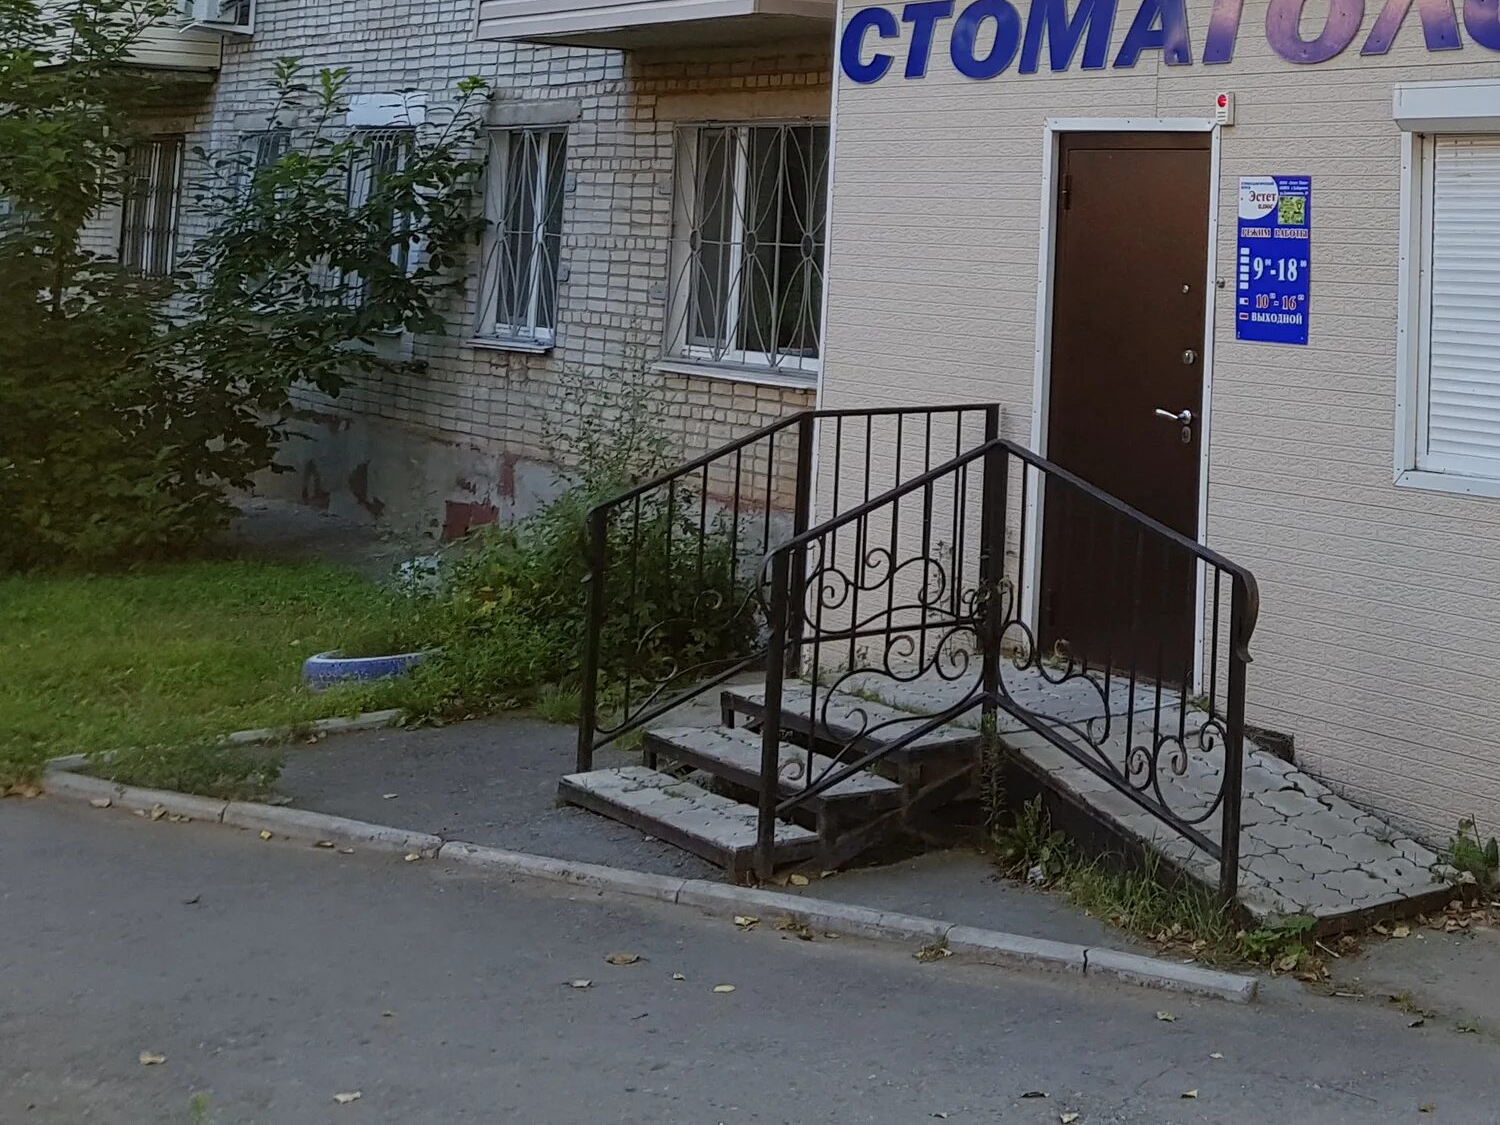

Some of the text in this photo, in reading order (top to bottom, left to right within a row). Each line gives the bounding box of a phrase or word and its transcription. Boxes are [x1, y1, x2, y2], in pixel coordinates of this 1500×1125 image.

[1248, 190, 1276, 202] Эстет
[1241, 227, 1308, 239] РЕЖИМ РАБОТЫ
[1251, 312, 1303, 324] ВЫХОДНОЙ
